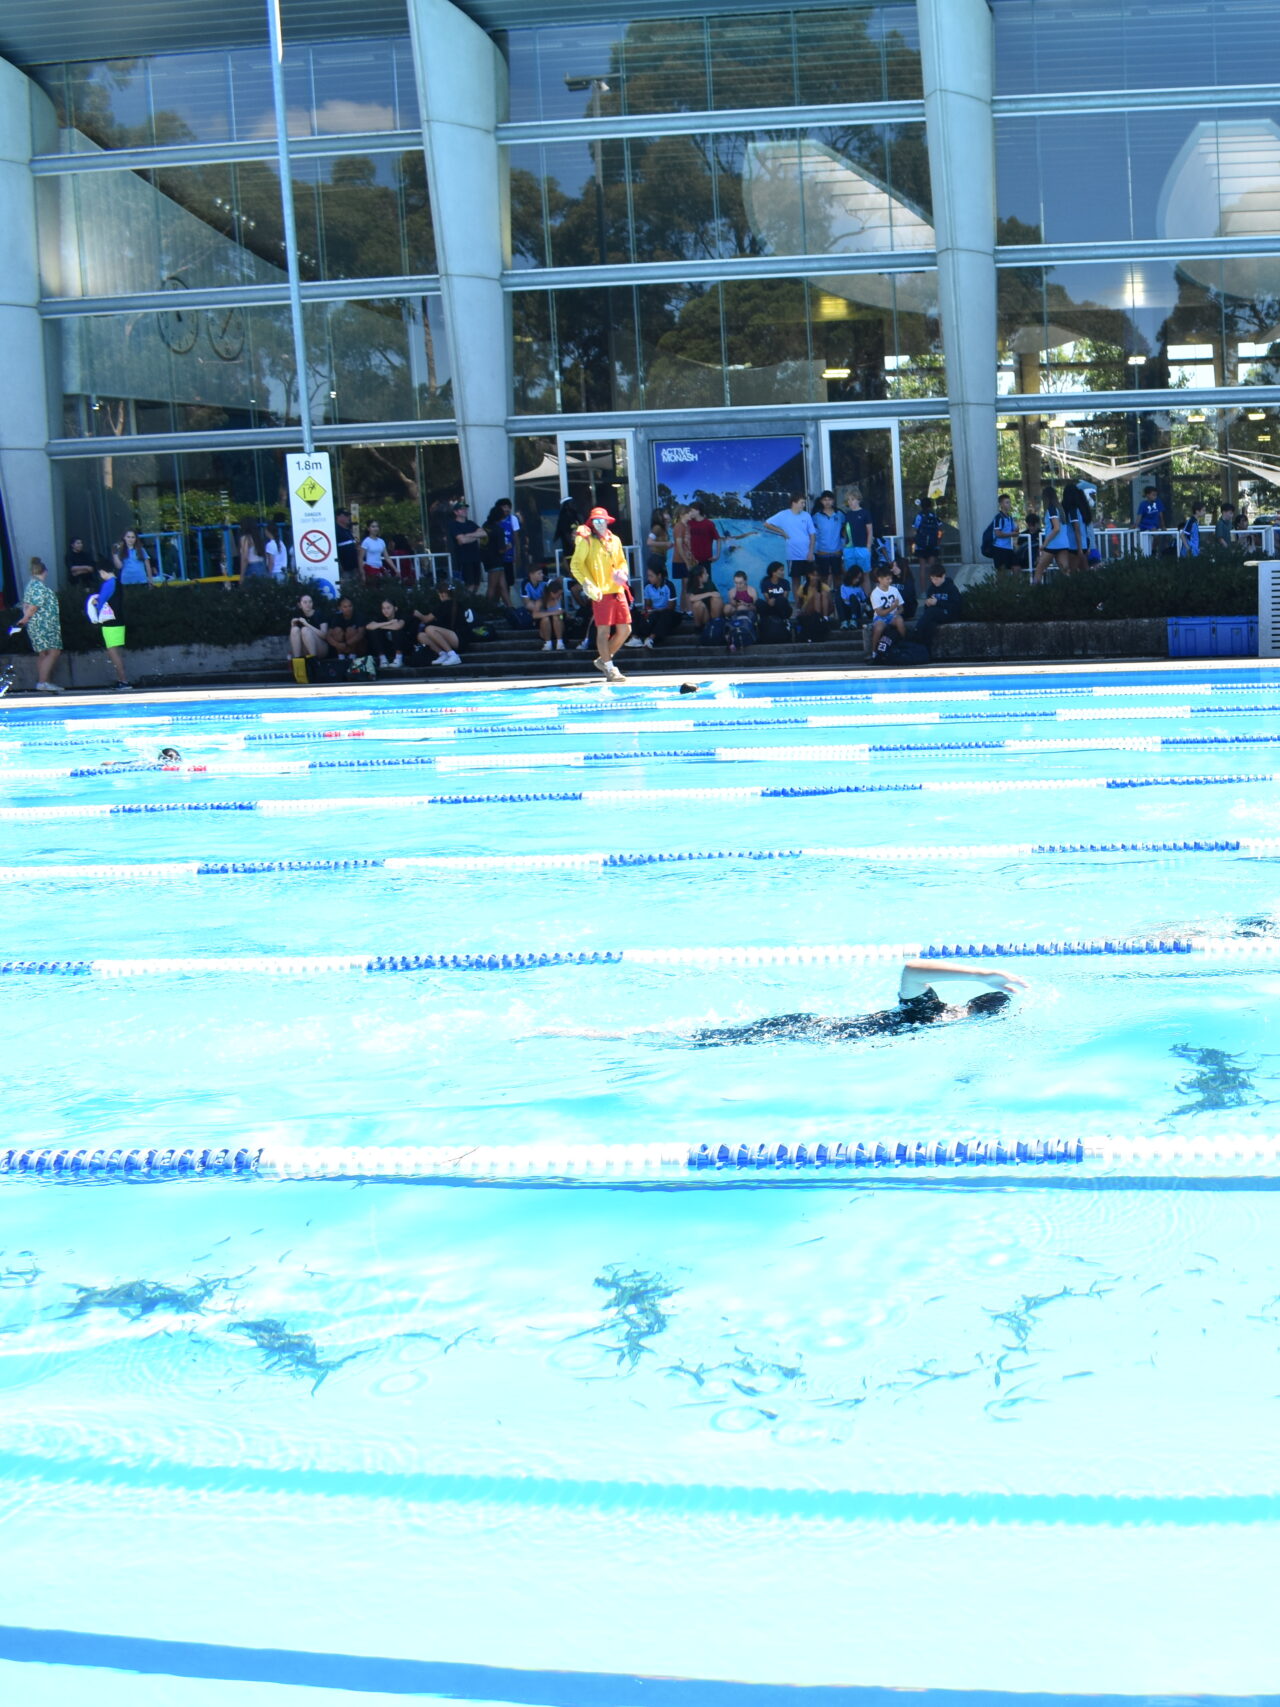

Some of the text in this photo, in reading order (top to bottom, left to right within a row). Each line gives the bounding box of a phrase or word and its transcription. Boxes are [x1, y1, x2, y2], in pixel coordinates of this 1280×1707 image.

[661, 447, 691, 456] ACTIVE
[662, 453, 698, 463] MONASH
[296, 460, 322, 470] 1.8m
